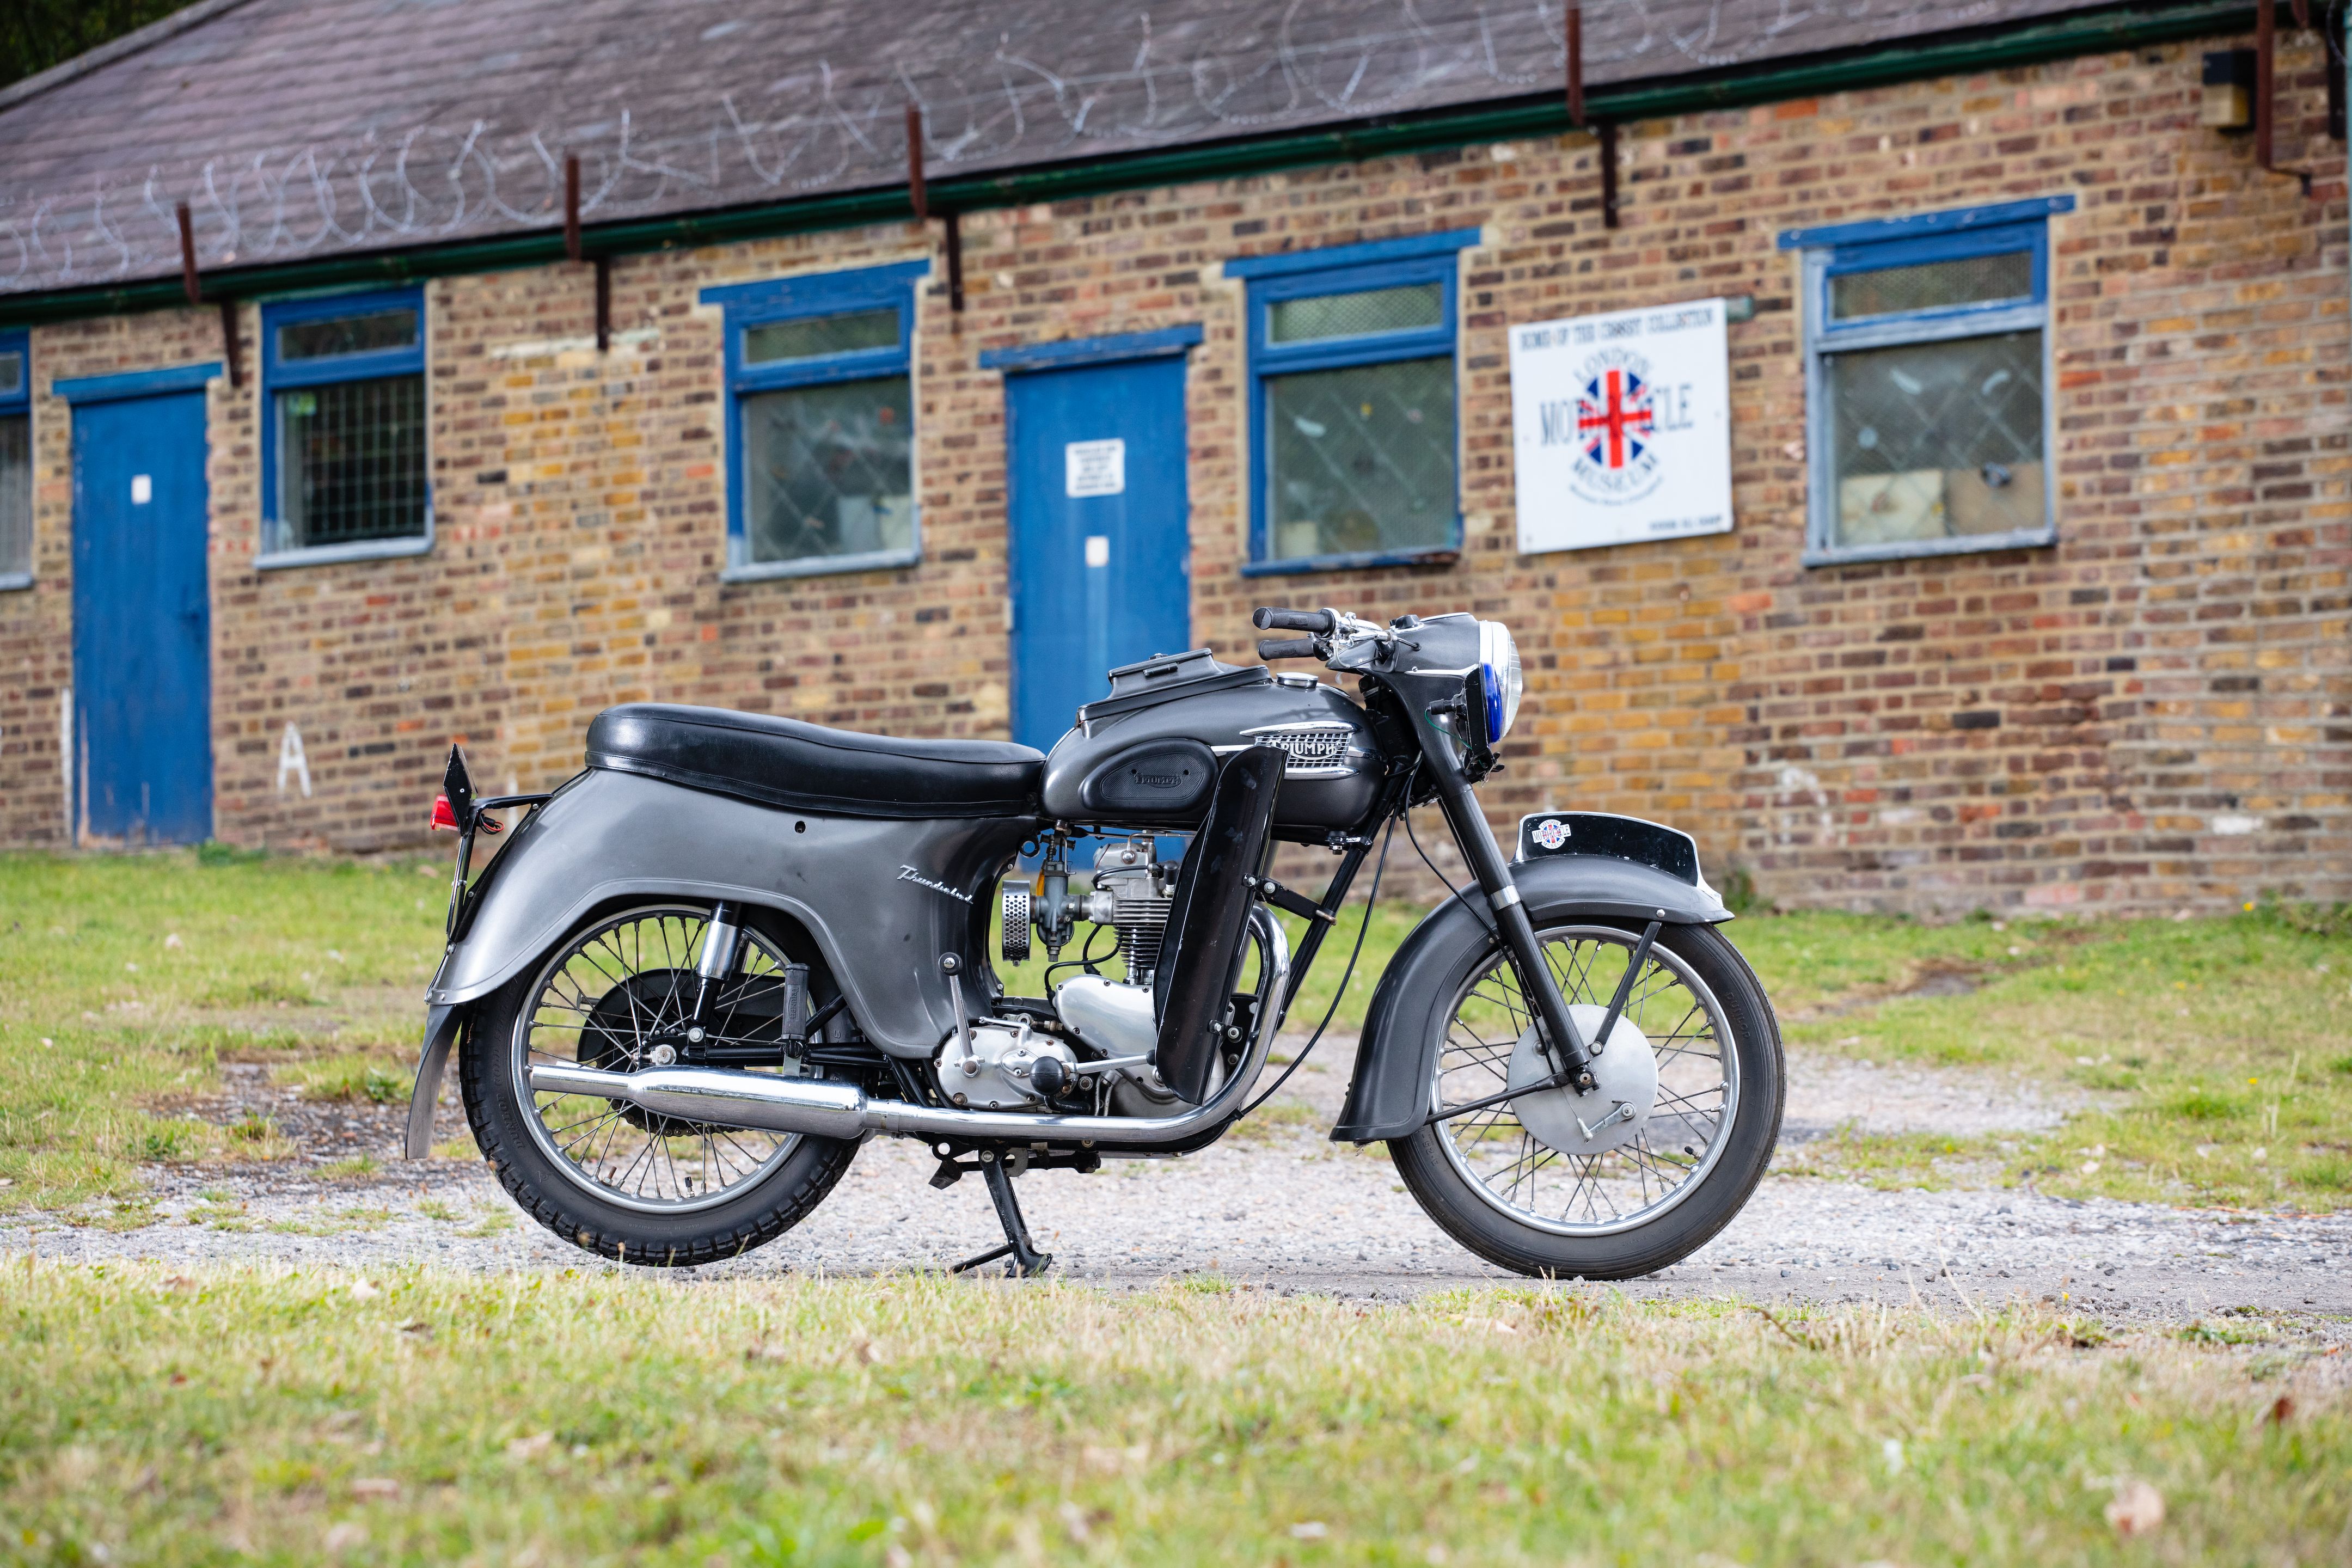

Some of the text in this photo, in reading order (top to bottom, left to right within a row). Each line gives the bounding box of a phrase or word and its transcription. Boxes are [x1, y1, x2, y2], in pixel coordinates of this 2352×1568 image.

[1573, 346, 1653, 383] LONDON
[1571, 453, 1658, 492] MUSEUM
[277, 721, 312, 798] A
[1268, 739, 1338, 759] TRIUMPH
[1533, 825, 1570, 841] MOTORCYCLE
[1541, 820, 1559, 828] LONDON
[1543, 838, 1564, 848] MUSEUM
[897, 865, 973, 904] Thunderbird
[788, 987, 799, 1019] TRIUMPH
[1725, 992, 1750, 1038] DUNLOP
[496, 1093, 524, 1149] DUNLOP
